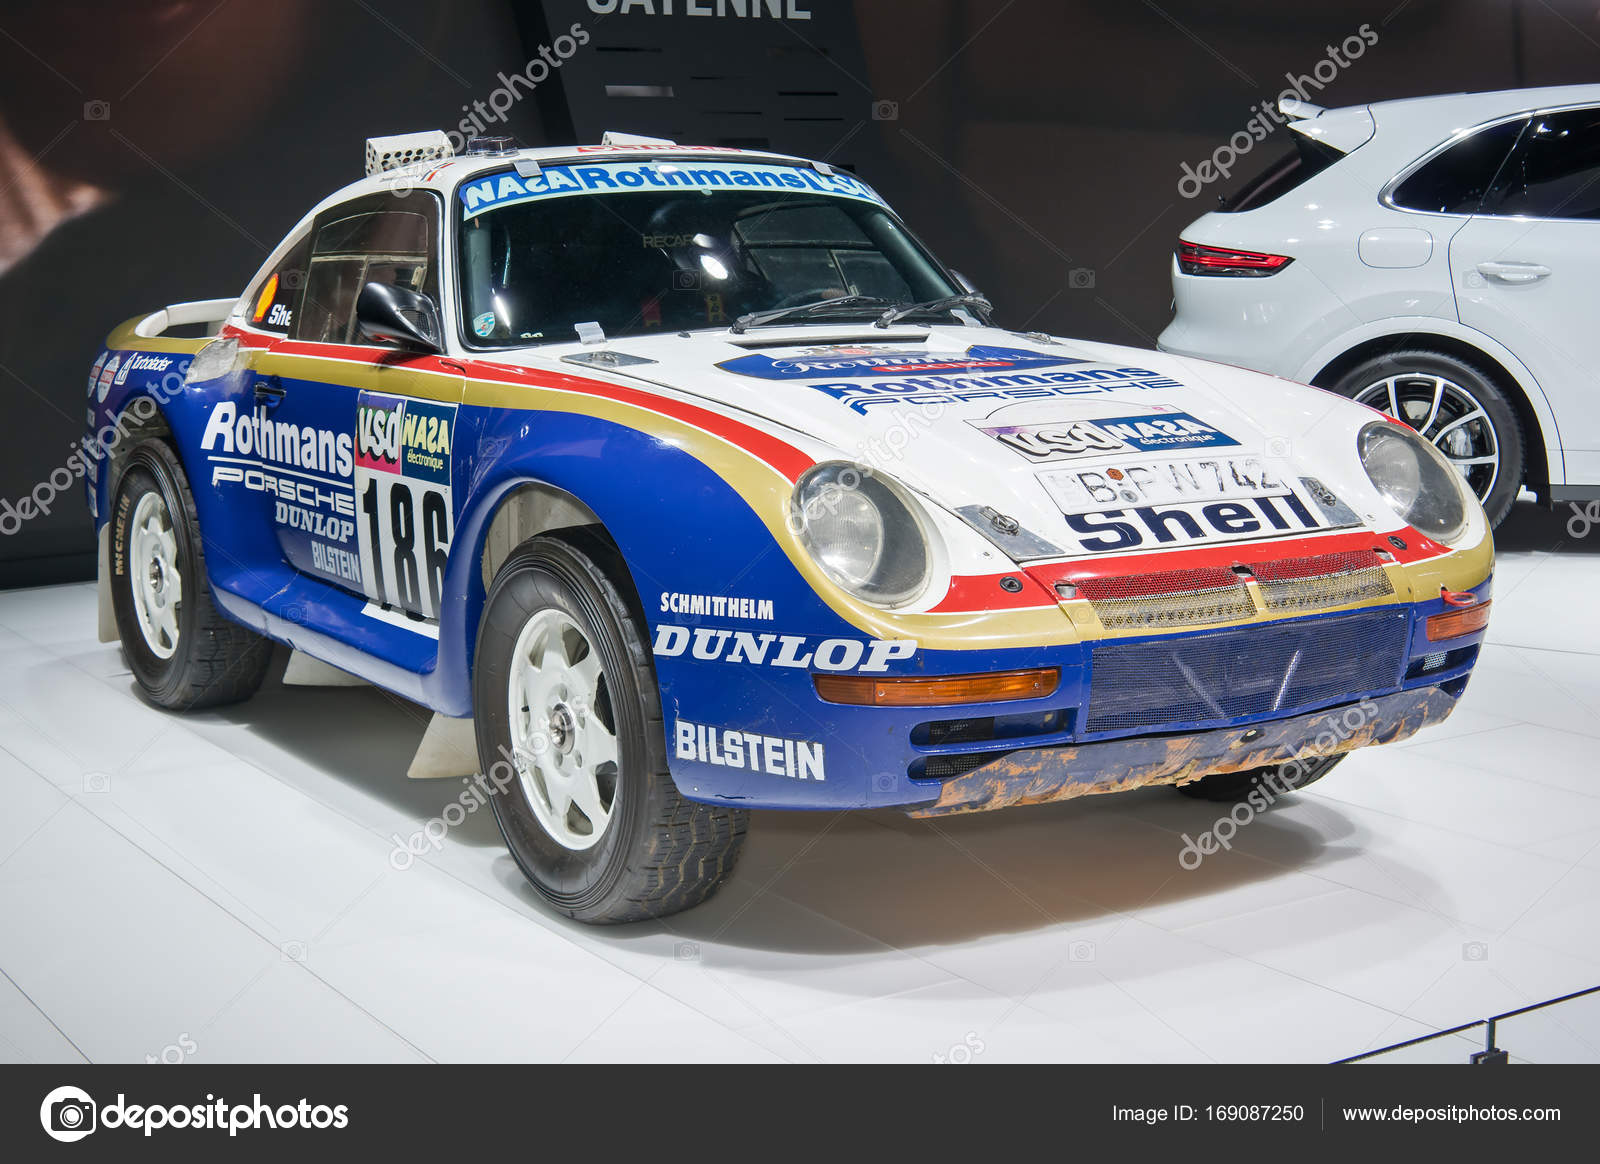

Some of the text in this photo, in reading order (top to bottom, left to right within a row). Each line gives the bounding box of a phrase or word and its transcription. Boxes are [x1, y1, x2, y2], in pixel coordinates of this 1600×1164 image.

[576, 166, 806, 190] Rothmans
[642, 232, 697, 249] RECAR
[806, 367, 1160, 400] Rothmans
[844, 378, 1184, 416] PORSCHE
[200, 401, 353, 478] Rothmans
[406, 450, 444, 472] électronique
[1139, 434, 1217, 447] électronique
[211, 467, 355, 517] PORSCHE
[115, 493, 132, 576] MICHELIN
[275, 501, 354, 544] DUNLOP
[1065, 487, 1321, 551] Shell
[311, 541, 362, 584] BILSTEIN
[362, 477, 450, 622] 186
[660, 591, 775, 621] SCHMITTHELM
[653, 624, 918, 673] DUNLOP
[675, 719, 826, 781] BILSTEIN
